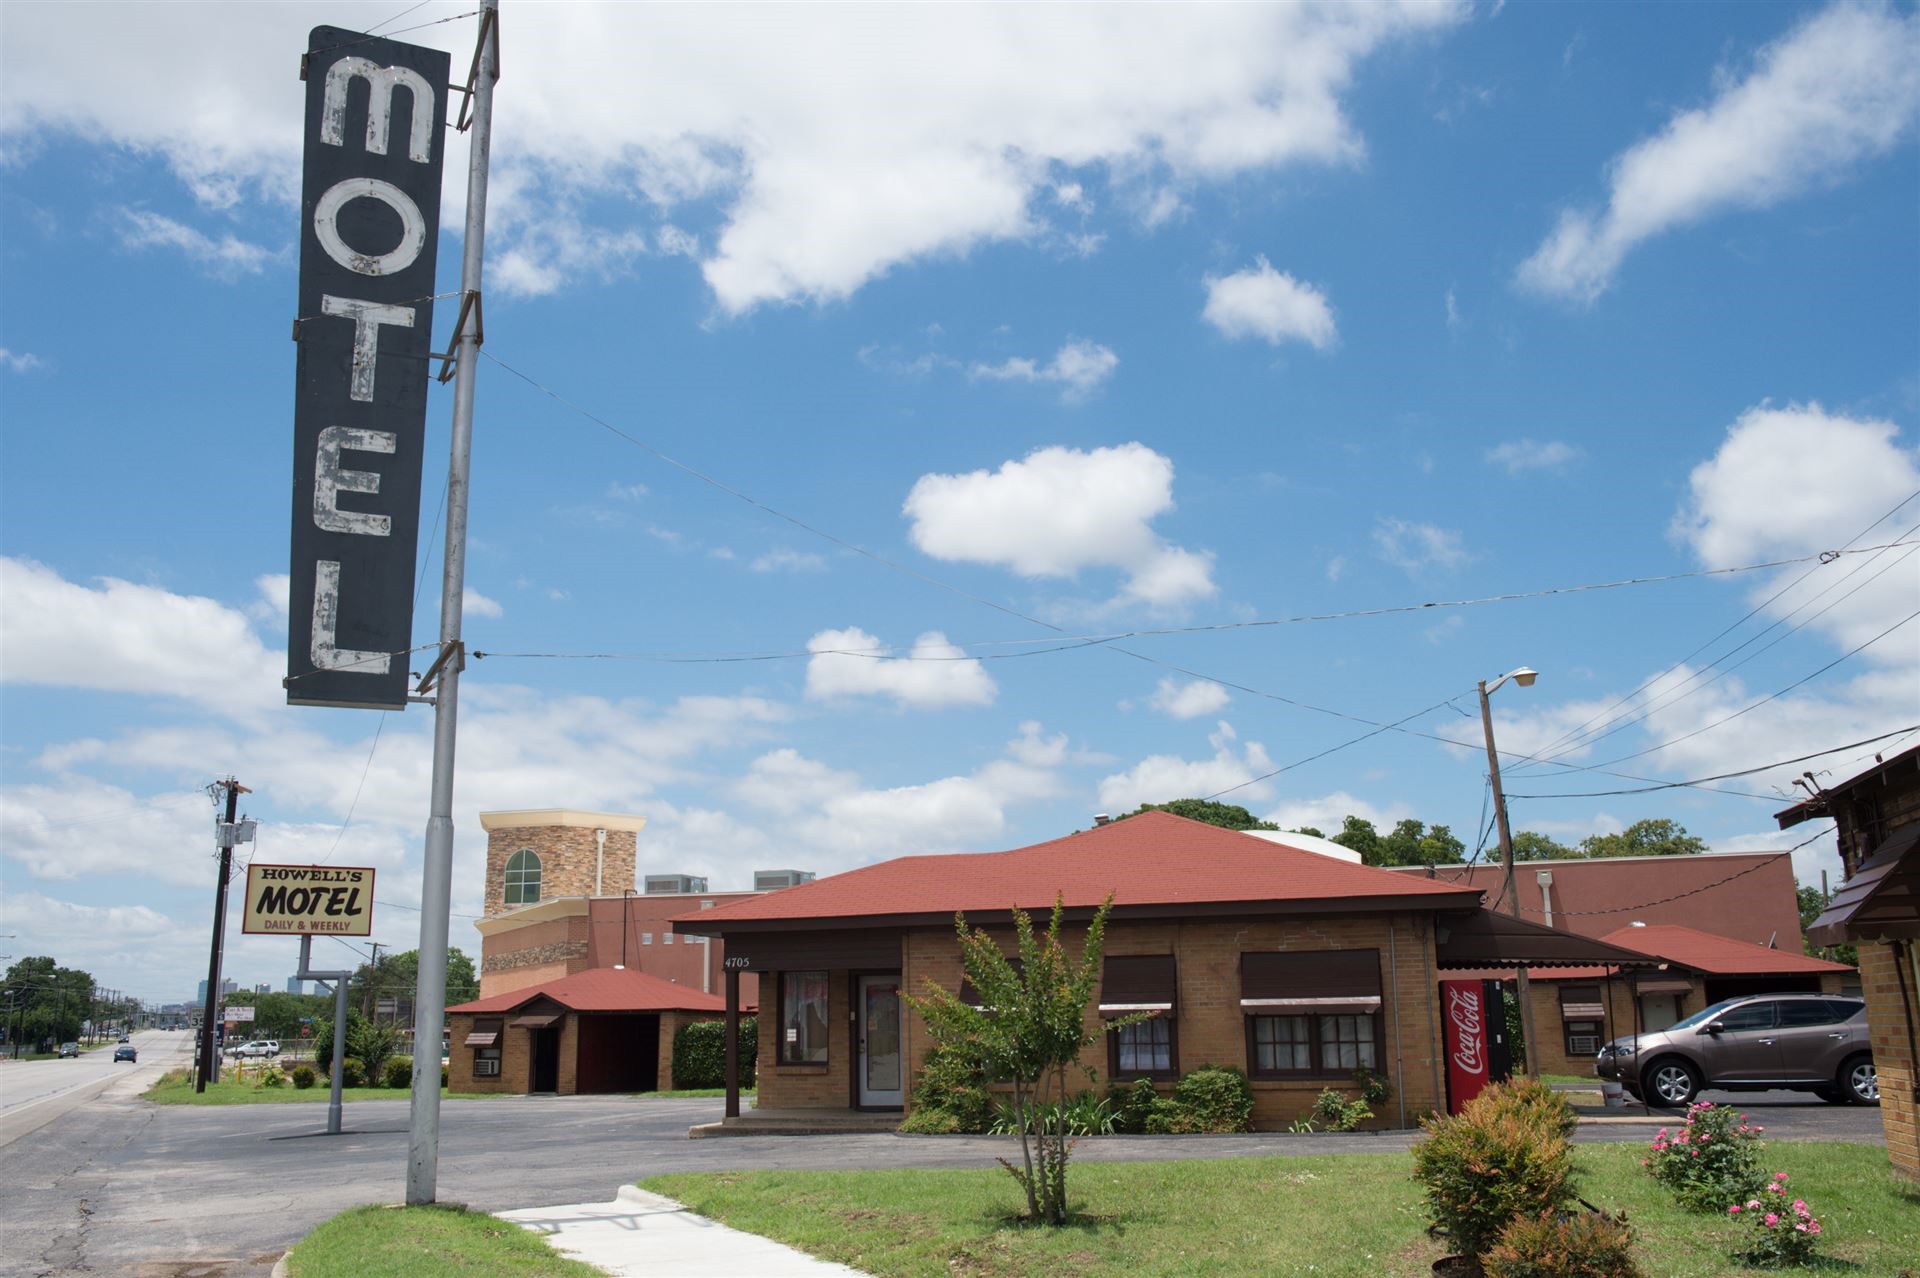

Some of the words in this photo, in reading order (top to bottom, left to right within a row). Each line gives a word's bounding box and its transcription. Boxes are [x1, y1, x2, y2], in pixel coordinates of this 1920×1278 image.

[311, 55, 436, 675] MOTEL
[261, 868, 362, 882] HOWELL'S
[256, 886, 361, 916] MOTEL
[264, 920, 293, 930] DAILY
[297, 921, 305, 930] &
[310, 921, 351, 931] WEEKLY
[725, 957, 749, 967] 4705
